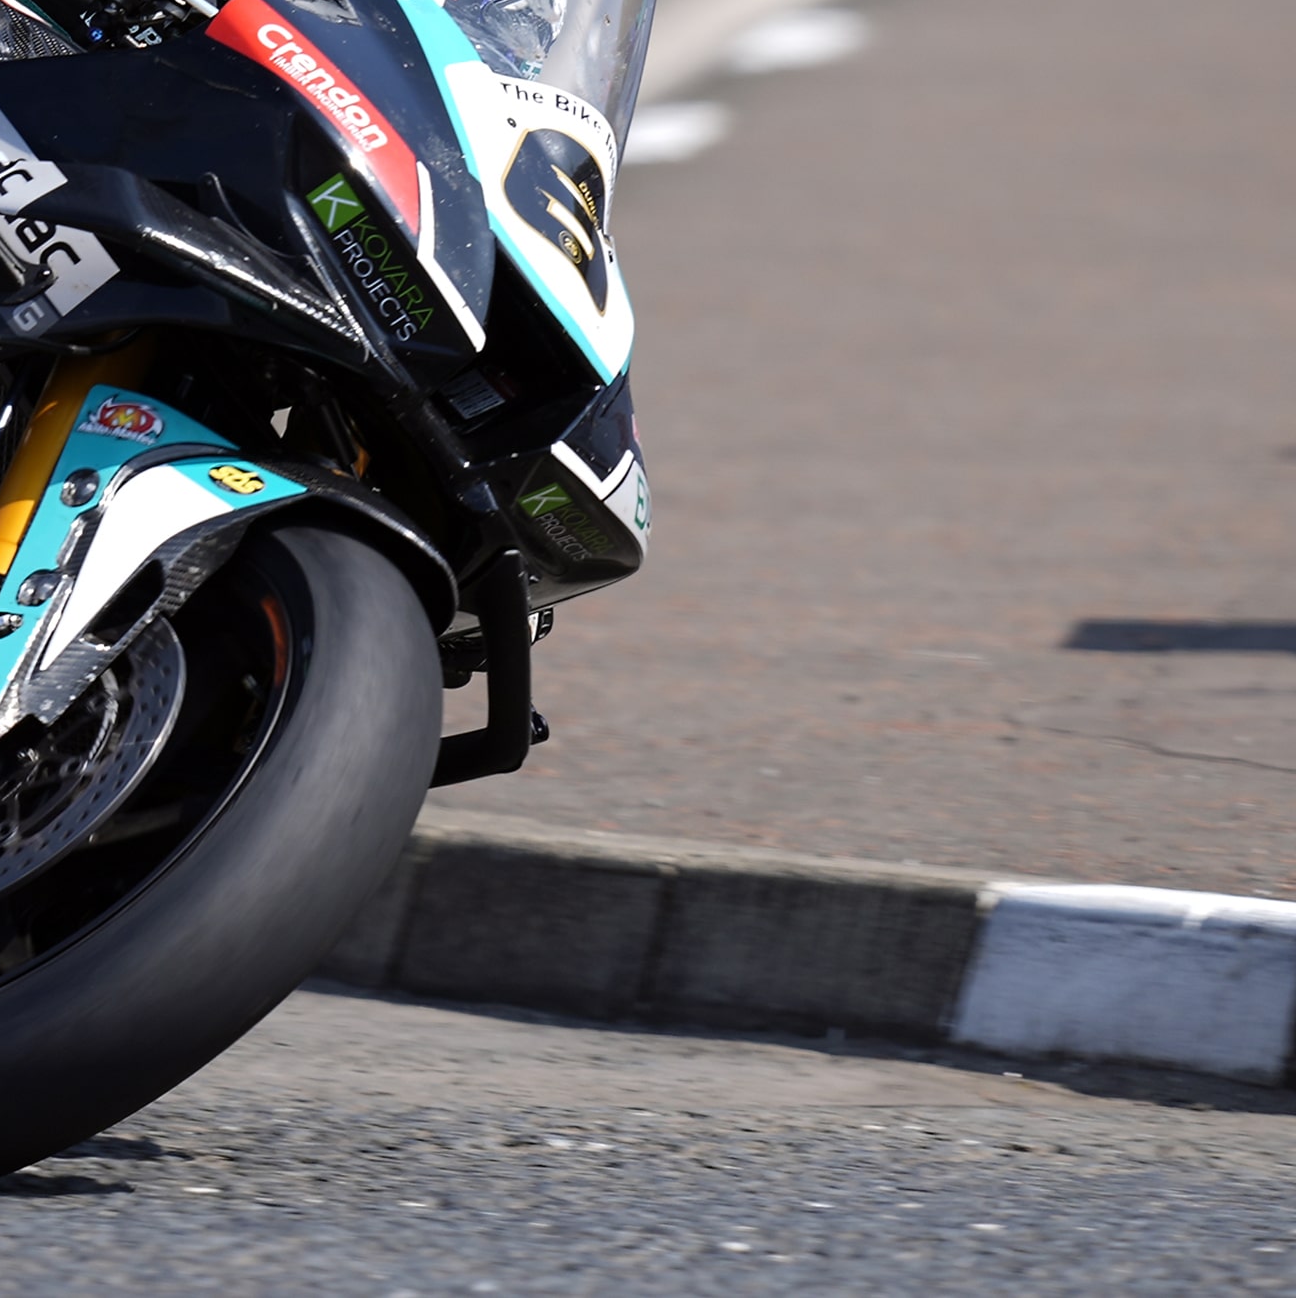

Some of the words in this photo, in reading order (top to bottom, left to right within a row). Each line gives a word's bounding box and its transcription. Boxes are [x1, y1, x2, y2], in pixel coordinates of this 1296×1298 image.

[255, 22, 389, 150] Crendon
[502, 82, 545, 105] The
[555, 92, 603, 134] Bike
[334, 229, 418, 342] PROJECTS
[352, 206, 436, 332] KOVARA
[208, 463, 266, 496] sbs
[536, 507, 589, 563] PROJECTS
